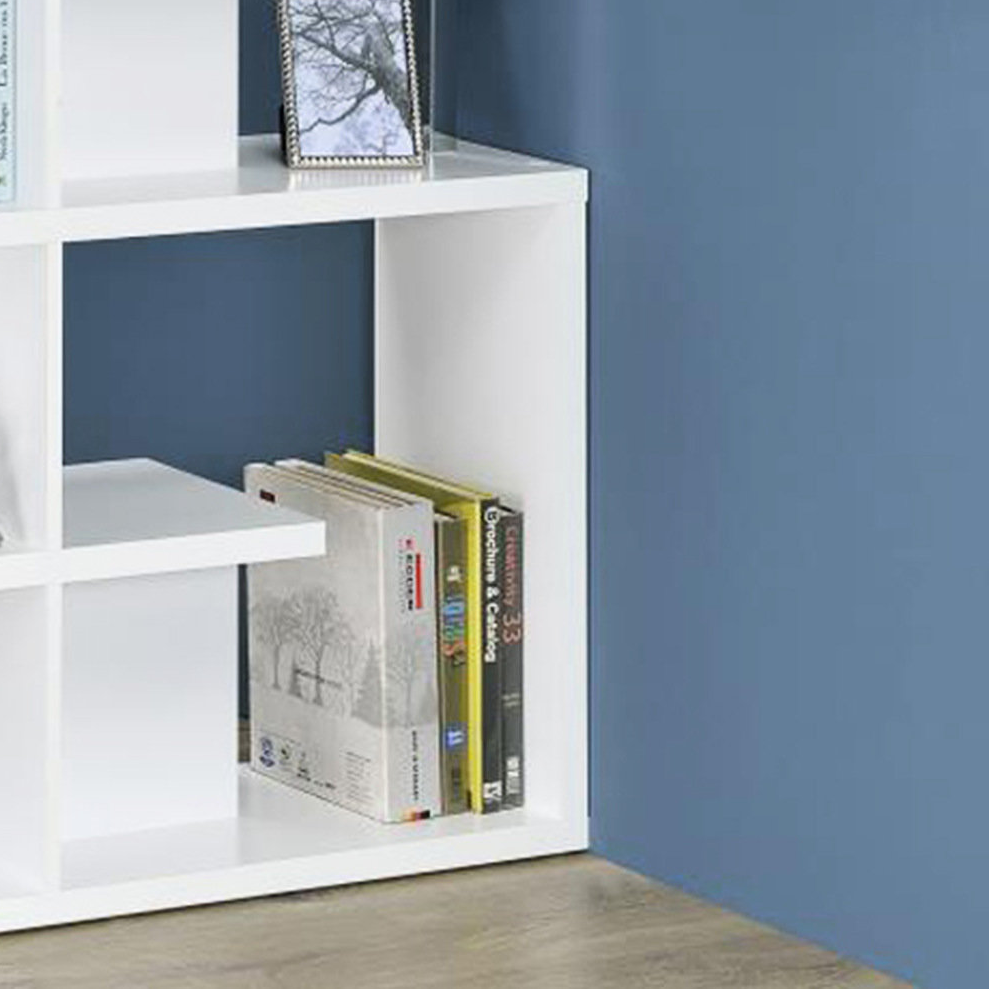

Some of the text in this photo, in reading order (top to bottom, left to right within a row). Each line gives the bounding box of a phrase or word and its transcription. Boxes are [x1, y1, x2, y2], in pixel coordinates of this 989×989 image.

[484, 506, 499, 663] Brochure & Catalog
[502, 612, 522, 645] 33
